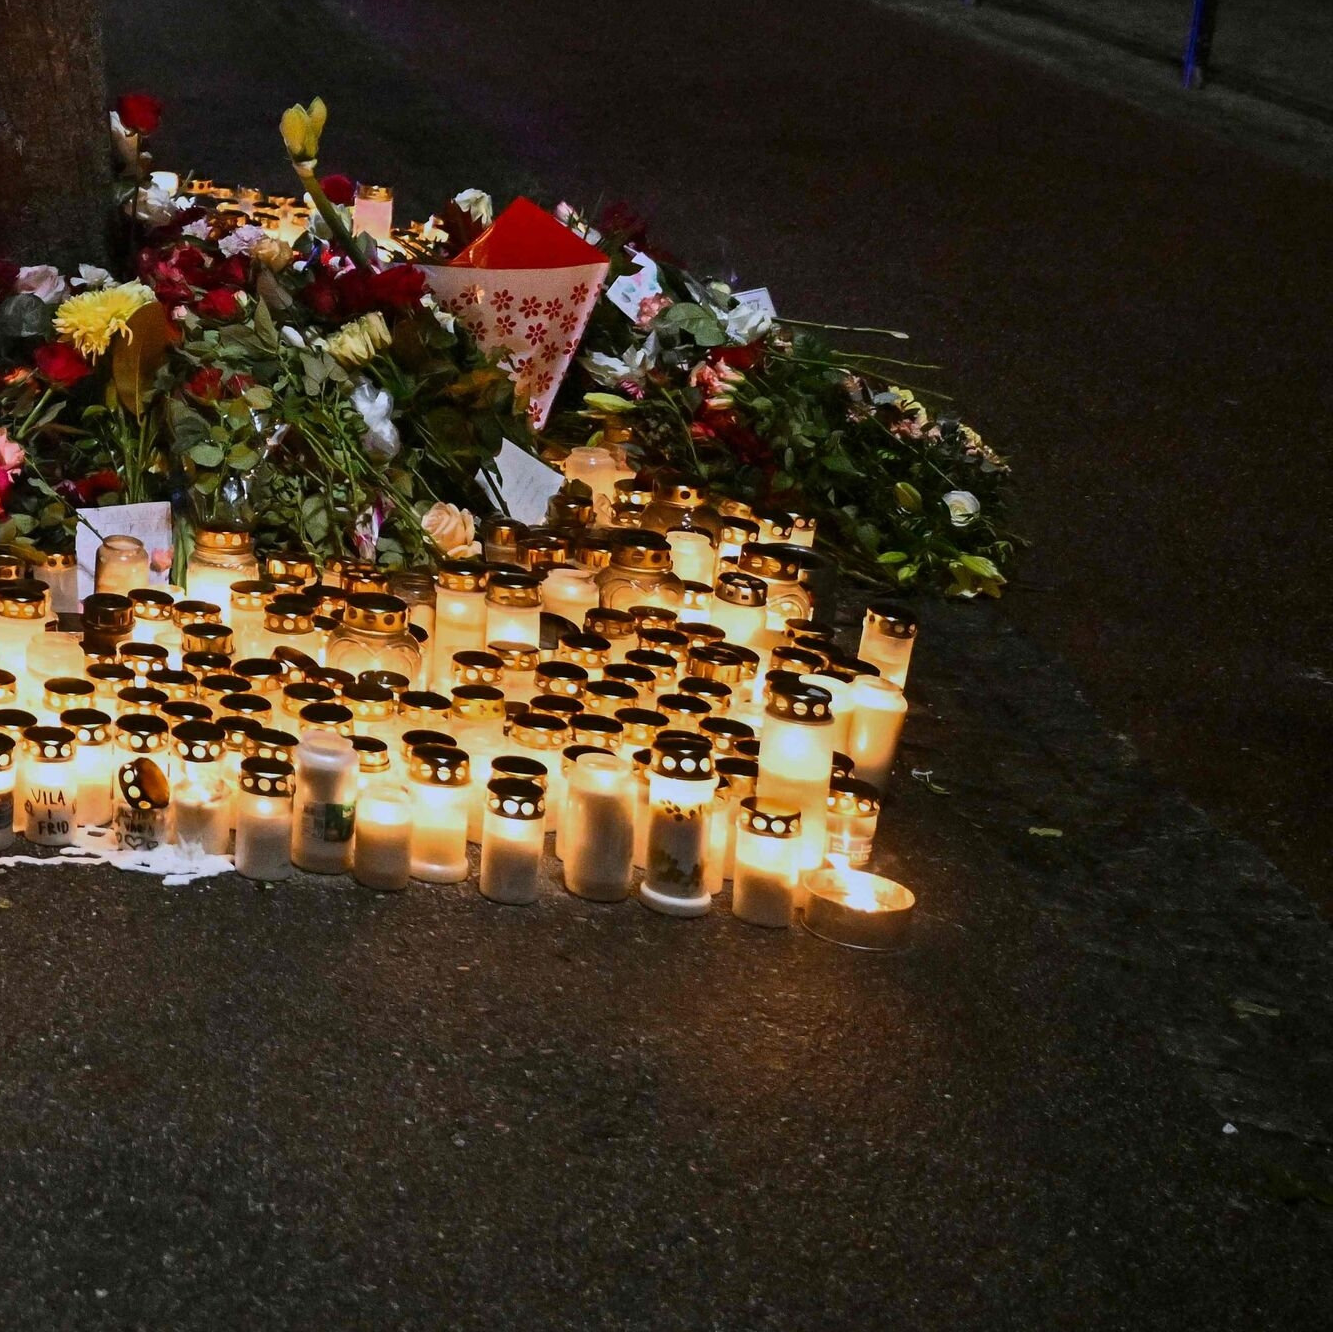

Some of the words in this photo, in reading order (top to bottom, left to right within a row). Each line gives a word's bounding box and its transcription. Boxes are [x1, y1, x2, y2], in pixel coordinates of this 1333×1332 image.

[30, 788, 66, 806] VILA
[47, 809, 52, 819] I
[37, 820, 69, 835] FRID
